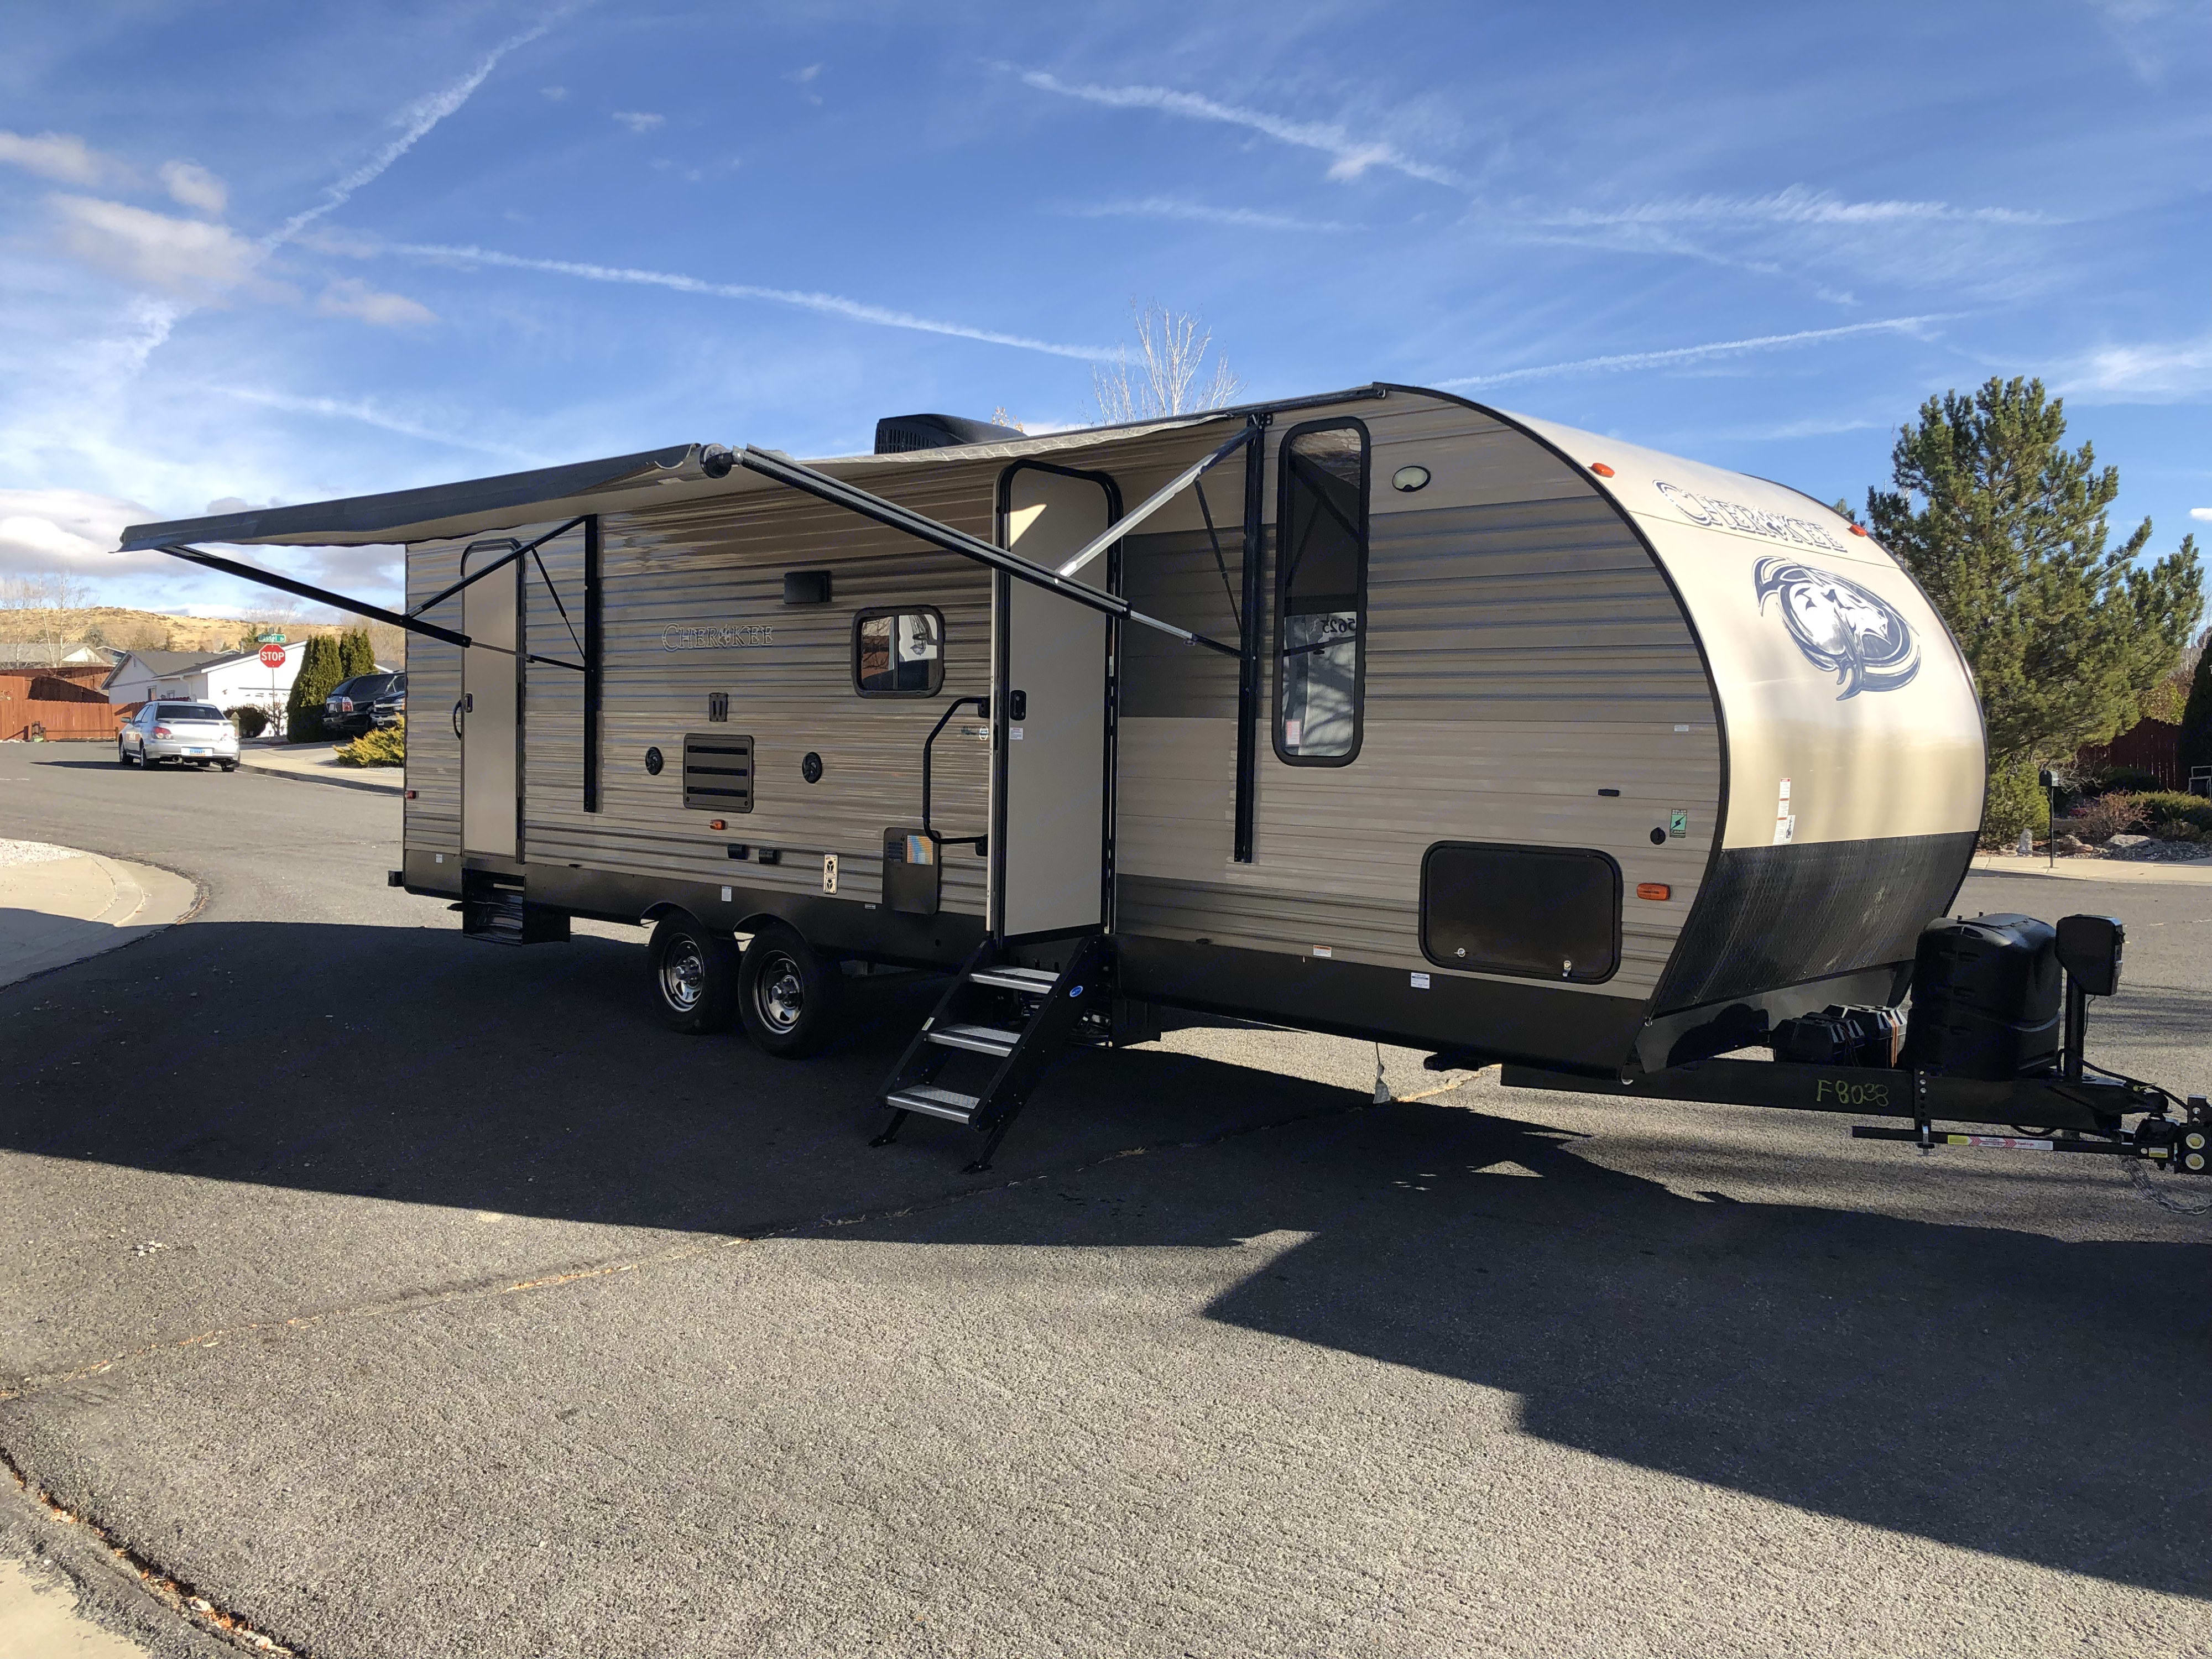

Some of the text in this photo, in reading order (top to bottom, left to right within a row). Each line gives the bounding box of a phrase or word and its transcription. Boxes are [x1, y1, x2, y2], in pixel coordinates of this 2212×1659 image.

[1652, 479, 1848, 552] CHEROKEE
[661, 623, 774, 652] CHEROKEE
[261, 651, 284, 661] STOP
